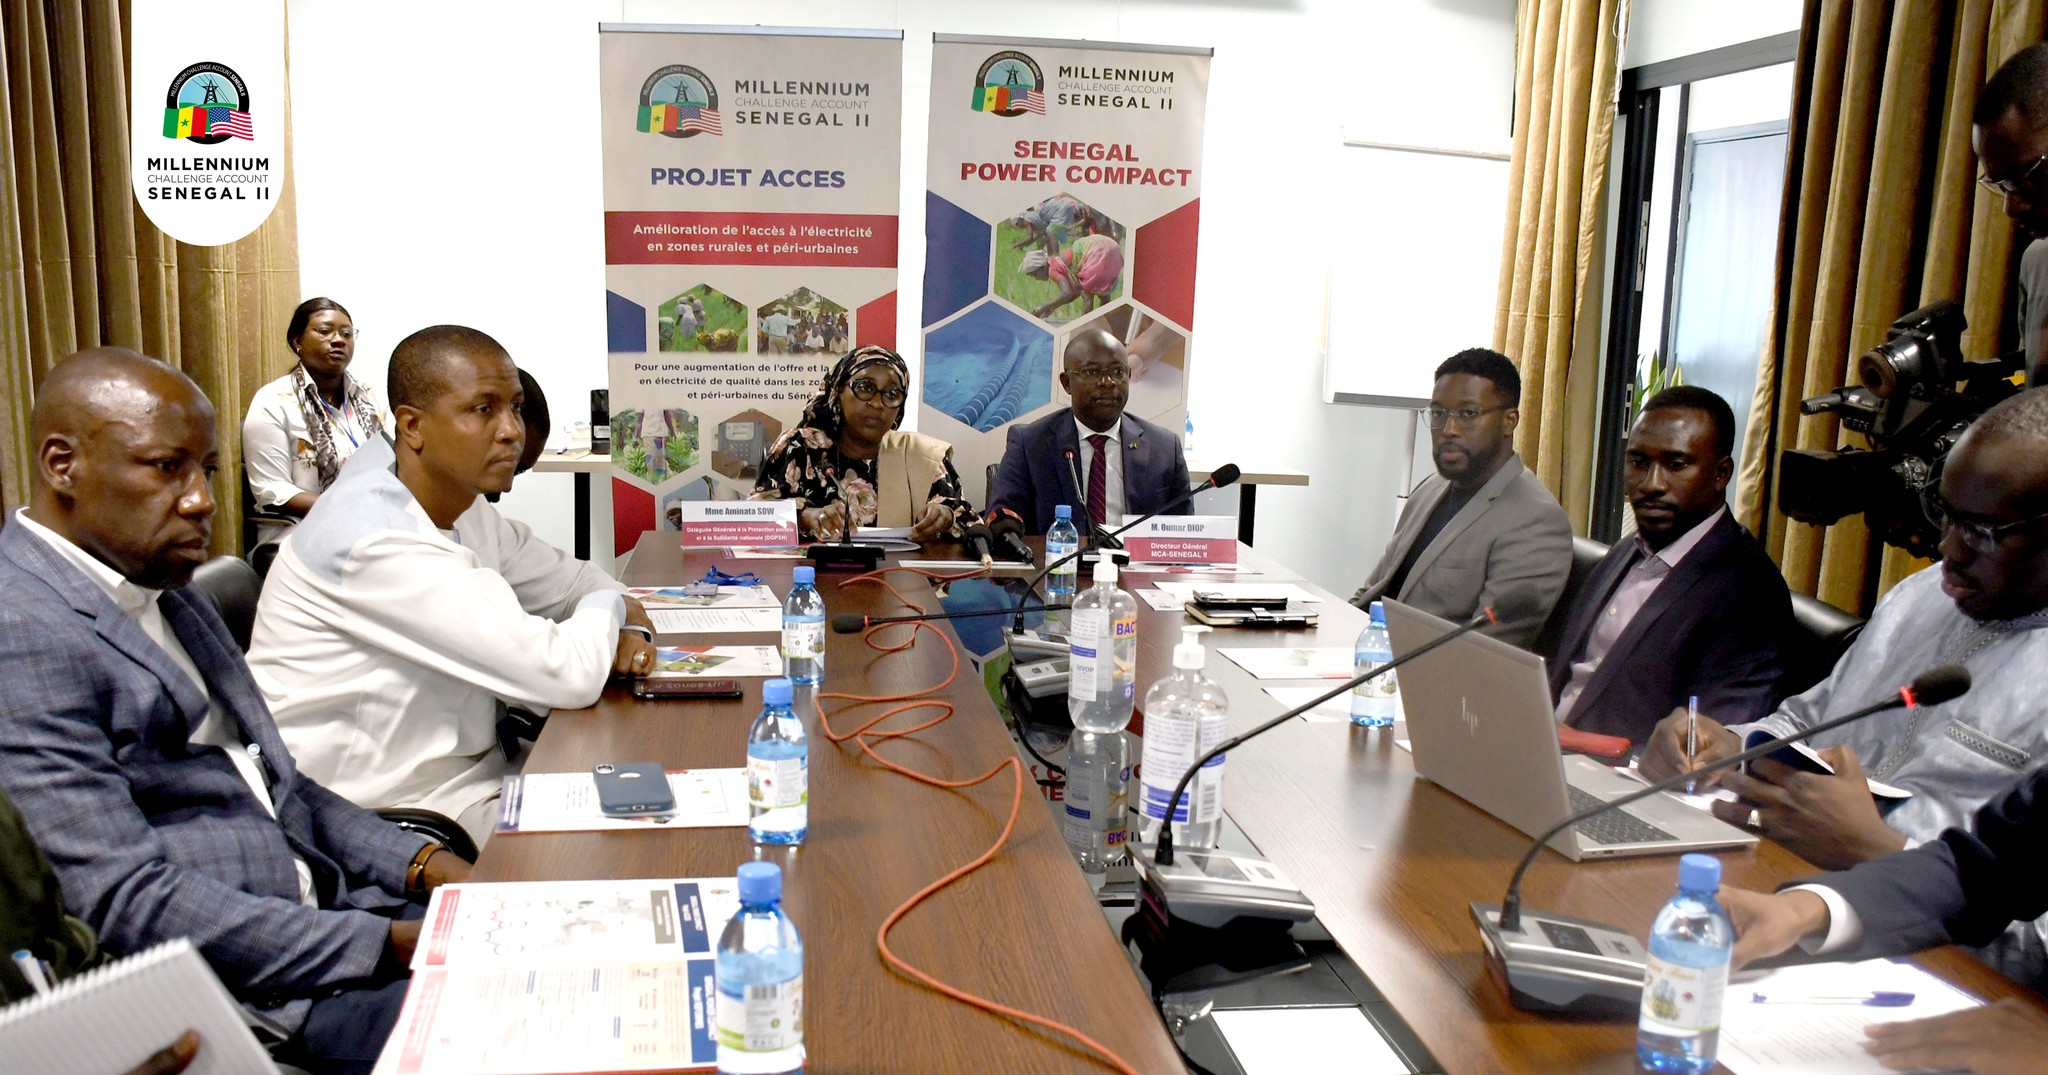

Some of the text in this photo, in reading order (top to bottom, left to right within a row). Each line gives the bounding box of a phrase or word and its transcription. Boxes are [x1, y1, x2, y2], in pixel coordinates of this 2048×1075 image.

[1059, 66, 1174, 83] MILLENNIUM
[735, 80, 869, 96] MILLENNIUM
[1058, 81, 1172, 95] CHALLENGE ACCOUNT
[735, 97, 869, 110] CHALLENGE ACCOUNT
[1058, 94, 1172, 110] SENEGAL II
[735, 111, 869, 127] SENEGAL II
[1014, 140, 1139, 162] SENEGAL
[651, 168, 846, 188] PROJET ACCES
[961, 163, 1192, 186] POWER COMPACT
[633, 224, 872, 238] Amélioration de l'accès à l'électricité
[647, 241, 859, 255] en zones rurales et péri-urbaines
[635, 363, 658, 372] Pour
[684, 363, 755, 373] augmentation
[758, 364, 771, 372] de
[774, 364, 804, 372] l'offre
[655, 377, 706, 385] électricité
[710, 377, 722, 385] de
[726, 377, 761, 387] qualité
[764, 378, 788, 386] dans
[791, 378, 805, 386] les
[701, 392, 768, 401] péri-urbaines
[772, 392, 784, 400] du
[788, 392, 812, 400] Séné
[1161, 524, 1185, 532] Oumar
[1187, 524, 1204, 532] DIOP
